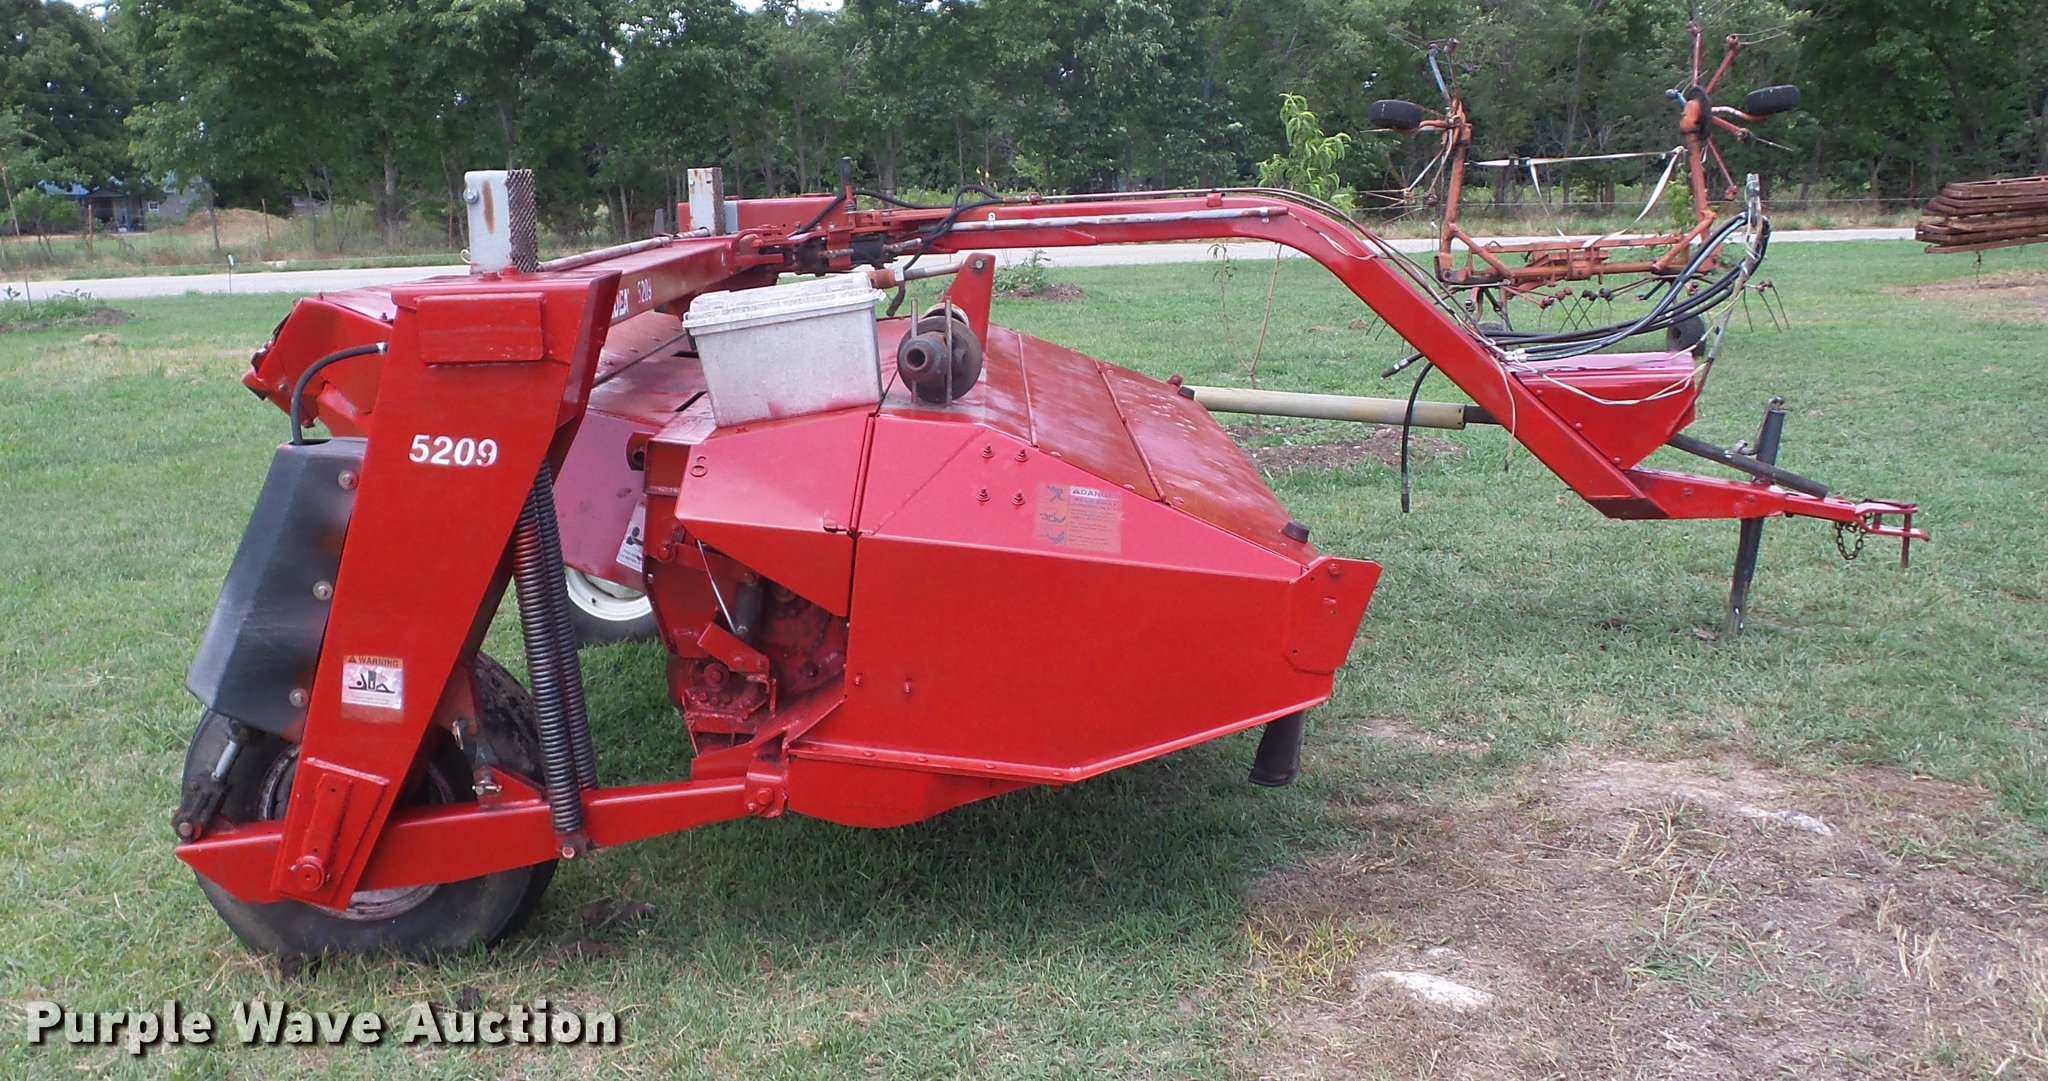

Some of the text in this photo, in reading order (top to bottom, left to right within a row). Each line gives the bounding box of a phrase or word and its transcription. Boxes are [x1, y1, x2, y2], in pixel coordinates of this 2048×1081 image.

[611, 278, 652, 319] DEA 5209
[409, 434, 498, 467] 5209
[358, 656, 399, 668] WARNING
